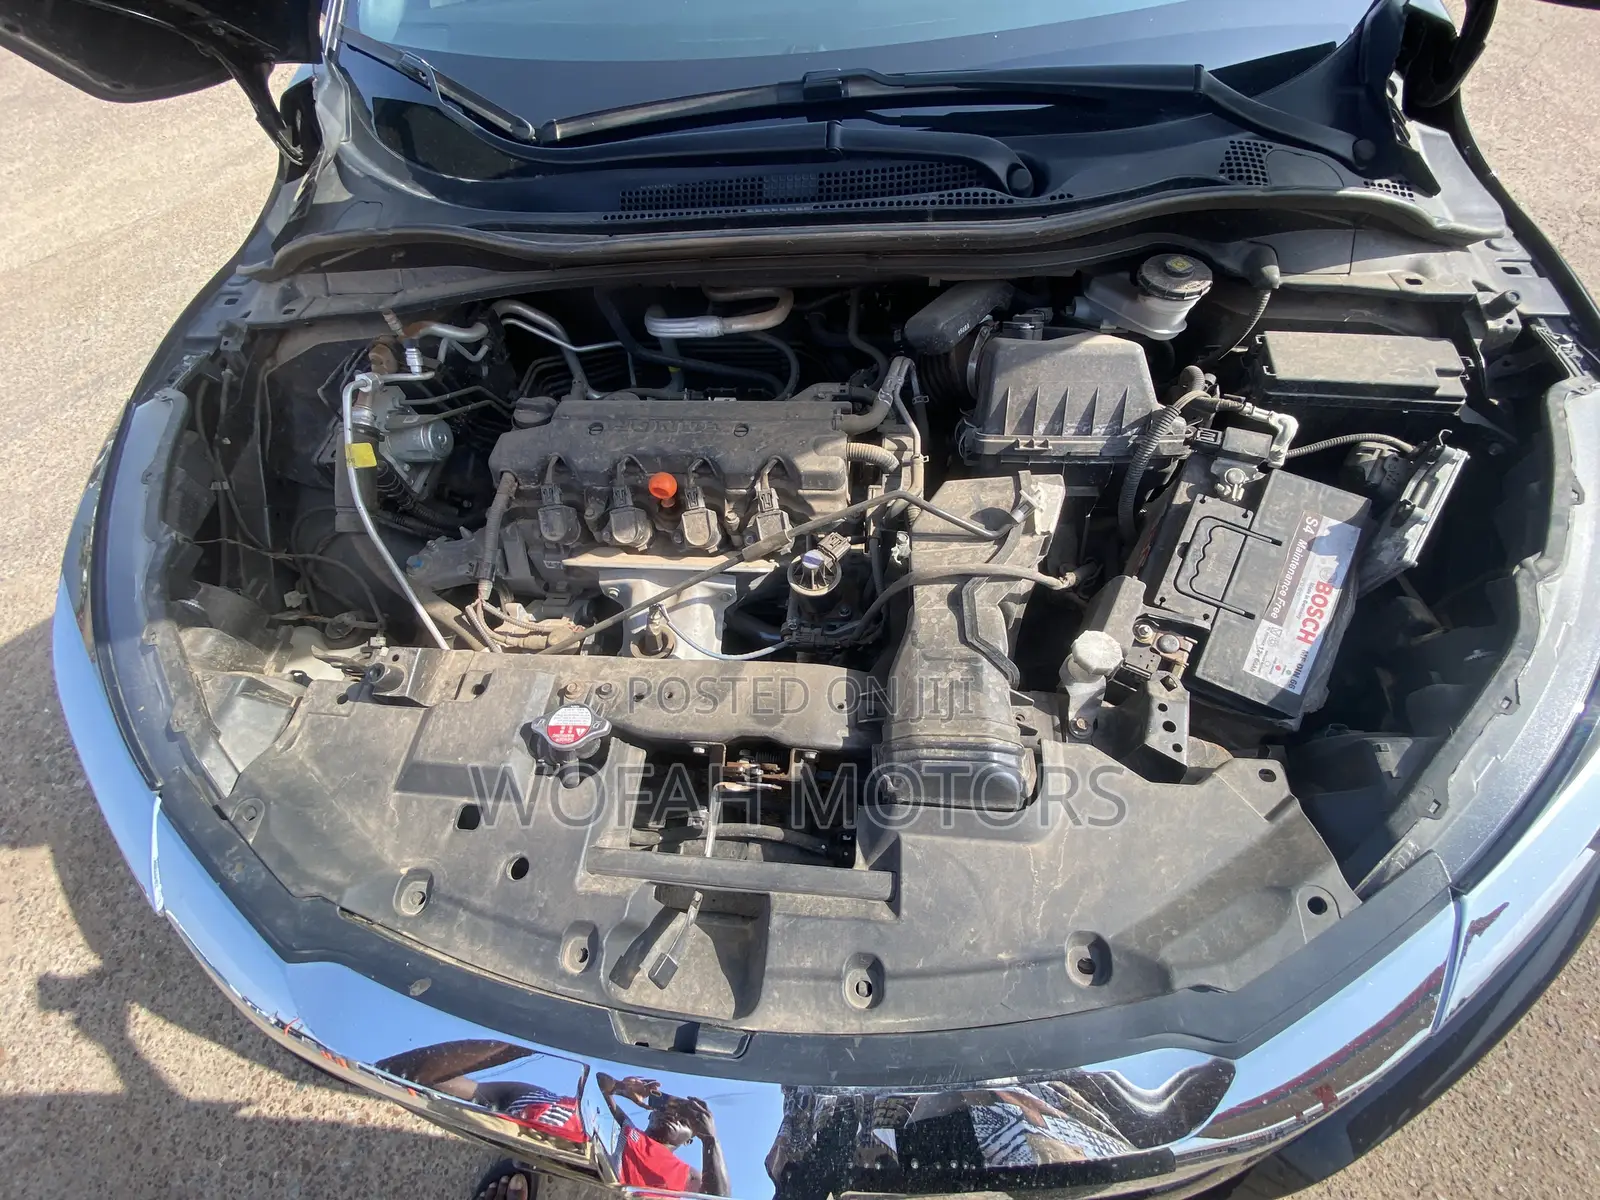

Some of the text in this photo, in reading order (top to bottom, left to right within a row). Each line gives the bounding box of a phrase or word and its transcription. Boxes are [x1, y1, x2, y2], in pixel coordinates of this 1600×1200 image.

[1303, 516, 1319, 535] S4
[1280, 538, 1308, 597] Maintenance
[1271, 597, 1286, 619] Free
[1296, 580, 1334, 646] BOSCH
